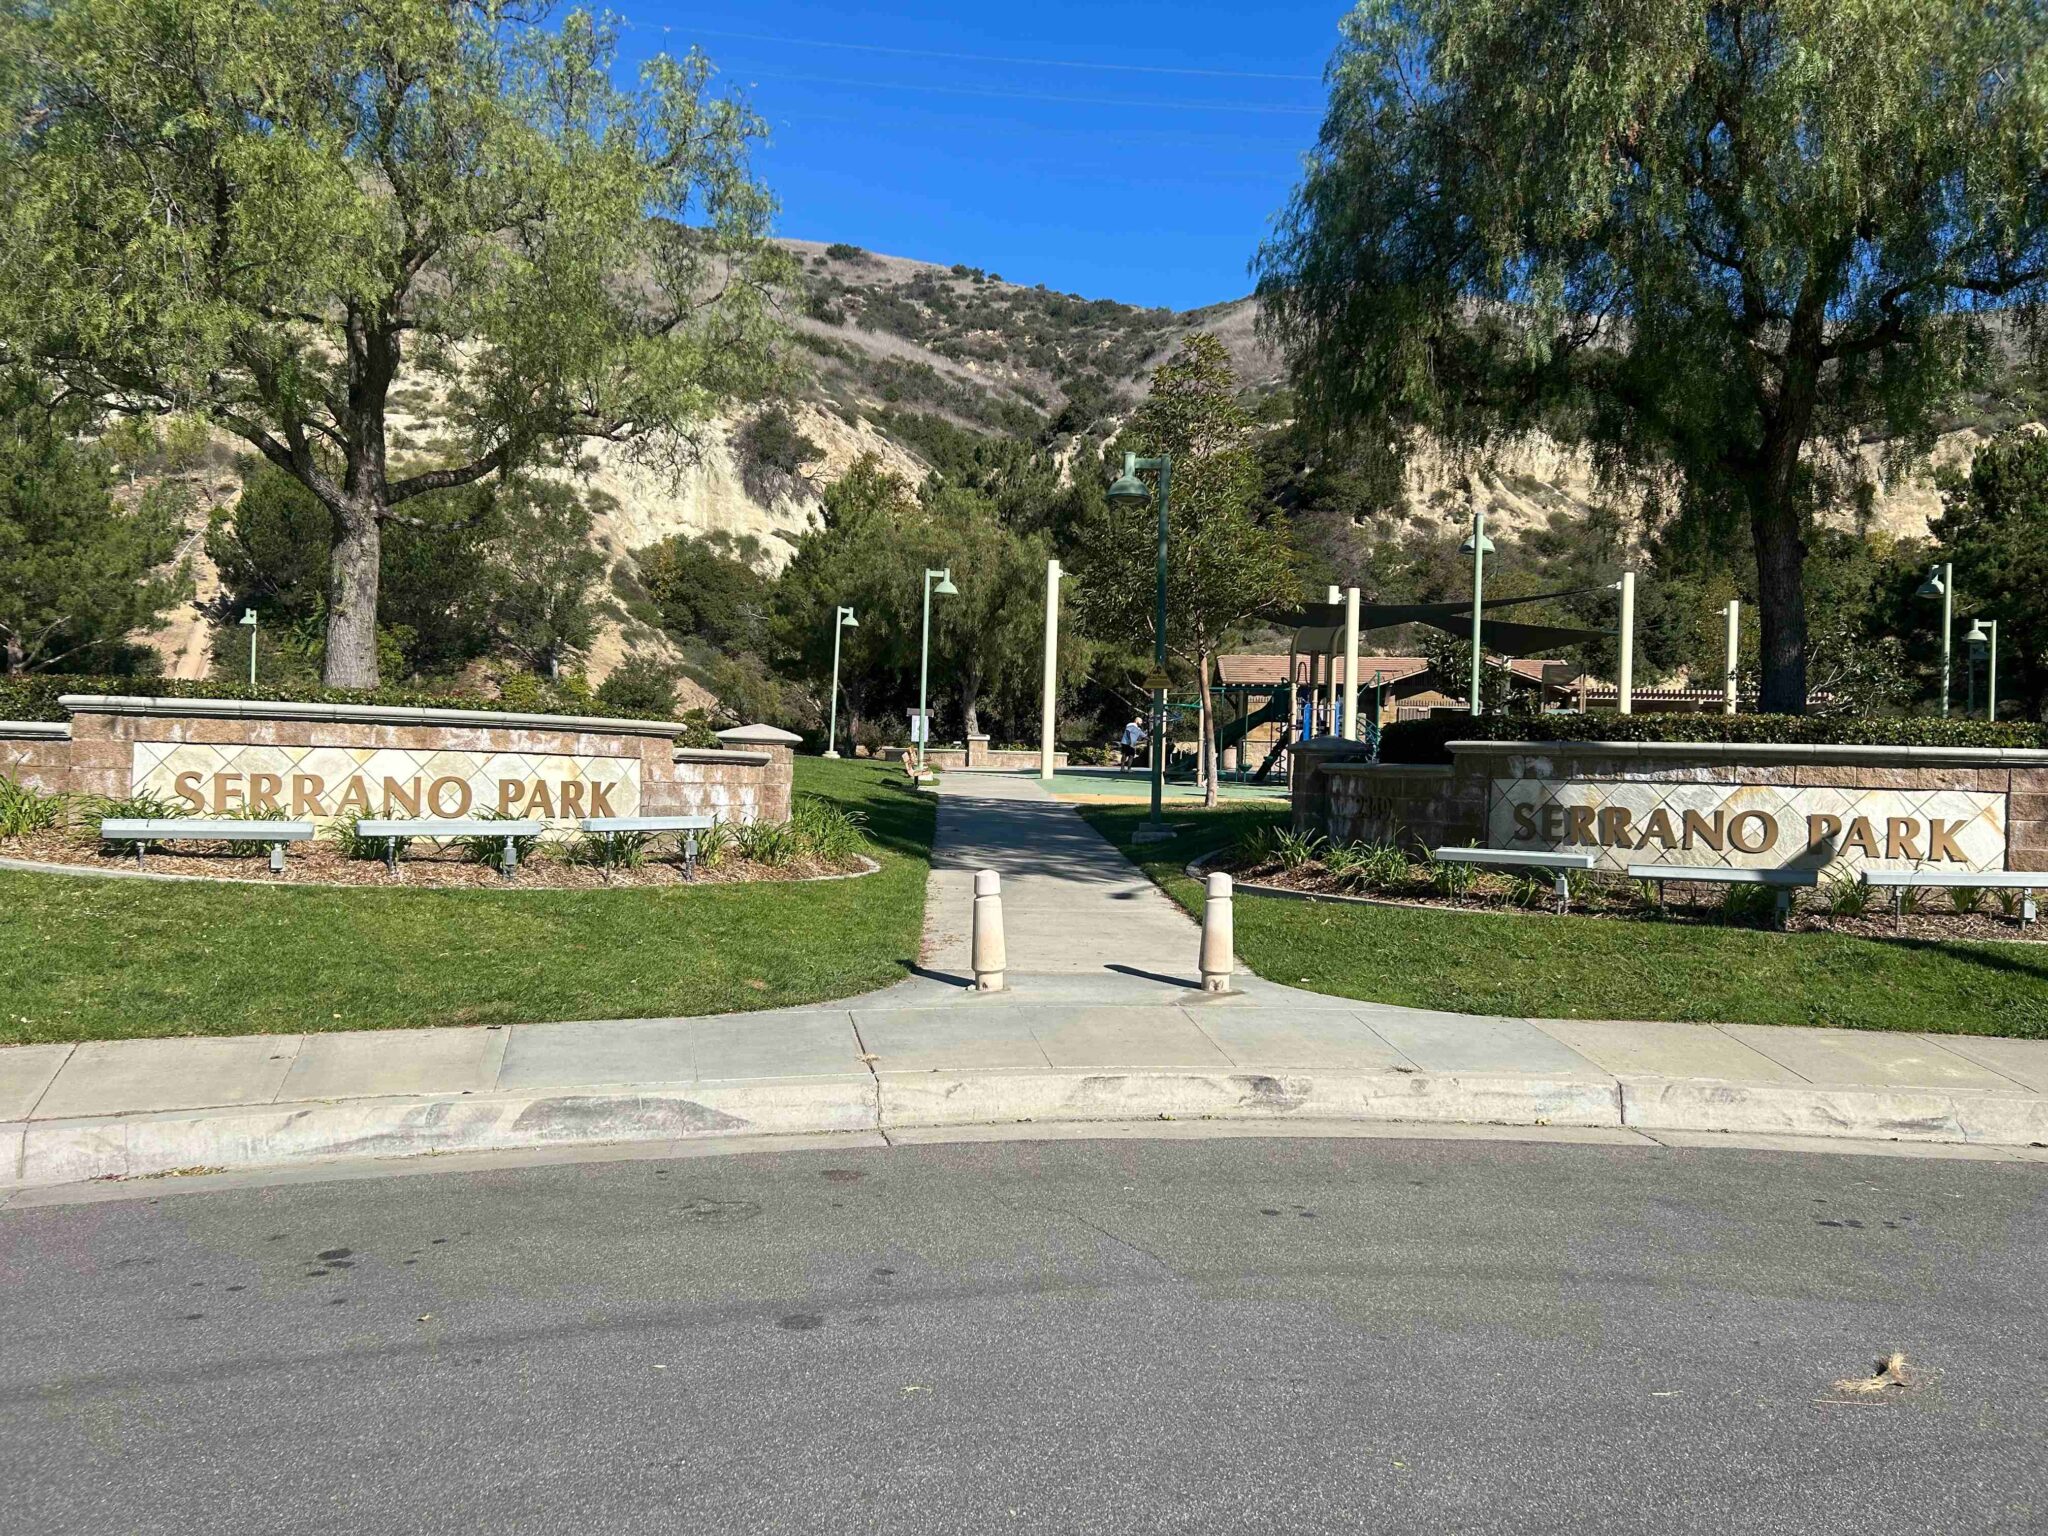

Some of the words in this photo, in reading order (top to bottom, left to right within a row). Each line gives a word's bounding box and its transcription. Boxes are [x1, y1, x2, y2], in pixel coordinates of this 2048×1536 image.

[174, 771, 472, 819] SERRANO
[499, 779, 616, 819] PARK
[1513, 802, 1779, 853] SERRANO
[1807, 814, 1968, 862] PARK
